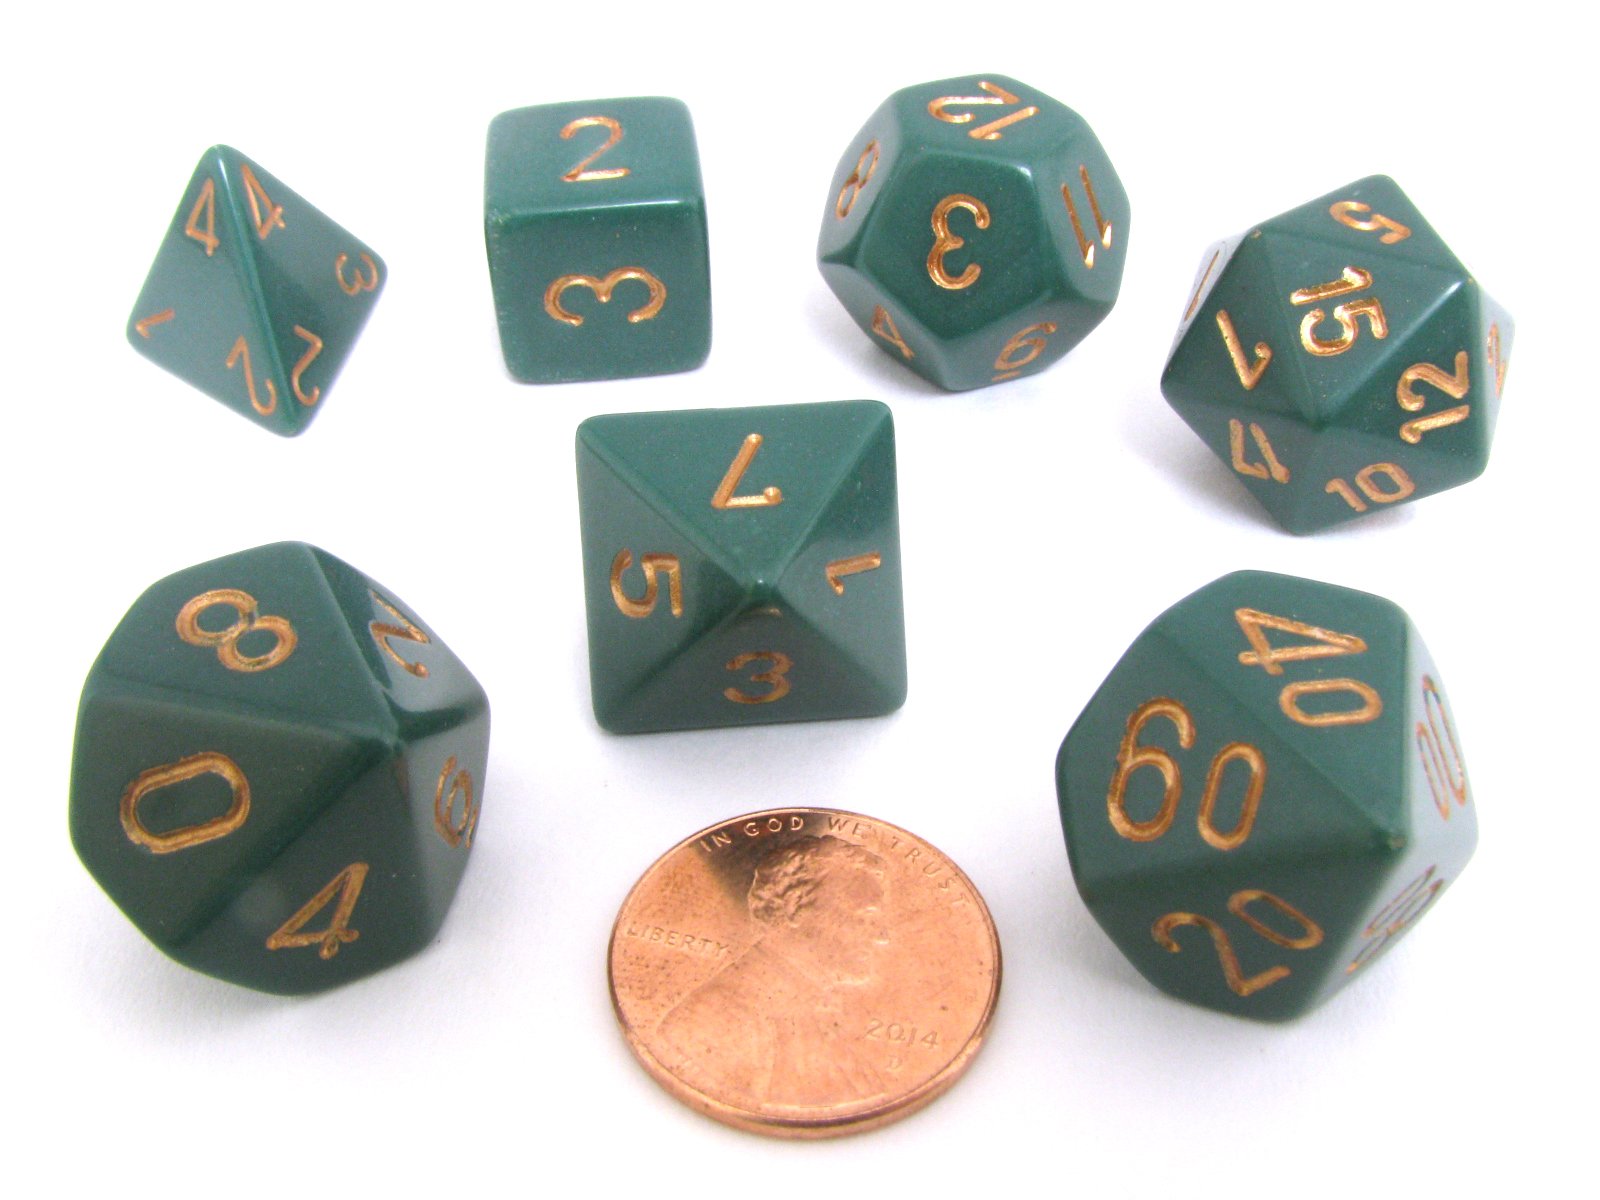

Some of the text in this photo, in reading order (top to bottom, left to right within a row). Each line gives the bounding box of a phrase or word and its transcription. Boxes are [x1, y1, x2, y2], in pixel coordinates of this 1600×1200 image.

[561, 116, 631, 182] 2
[928, 81, 1039, 140] 12
[185, 178, 220, 257] 4
[241, 163, 286, 240] 4
[836, 138, 880, 220] 8
[1060, 165, 1112, 269] 11
[926, 193, 991, 290] 3
[1329, 200, 1412, 245] 5
[335, 252, 379, 296] 3
[544, 266, 667, 326] 3
[1290, 266, 1389, 357] 15
[135, 308, 175, 338] 1
[871, 304, 915, 360] 4
[991, 321, 1058, 381] 6
[1216, 309, 1274, 391] 7
[225, 335, 277, 416] 2
[290, 325, 324, 407] 2
[1396, 350, 1470, 445] 12
[711, 433, 783, 510] 7
[1228, 418, 1292, 485] 17
[1325, 462, 1416, 513] 10
[610, 548, 684, 619] 5
[825, 551, 883, 596] 1
[175, 588, 298, 673] 8
[370, 588, 431, 679] 2
[1235, 607, 1383, 728] 40
[724, 651, 794, 705] 3
[119, 751, 251, 855] 0
[434, 755, 480, 849] 6
[1106, 696, 1268, 852] 60
[700, 816, 971, 907] IN GOD WE TRUST
[265, 862, 370, 960] 4
[626, 921, 730, 958] LIBERTY
[1151, 889, 1324, 997] 20
[864, 1017, 939, 1051] 2014
